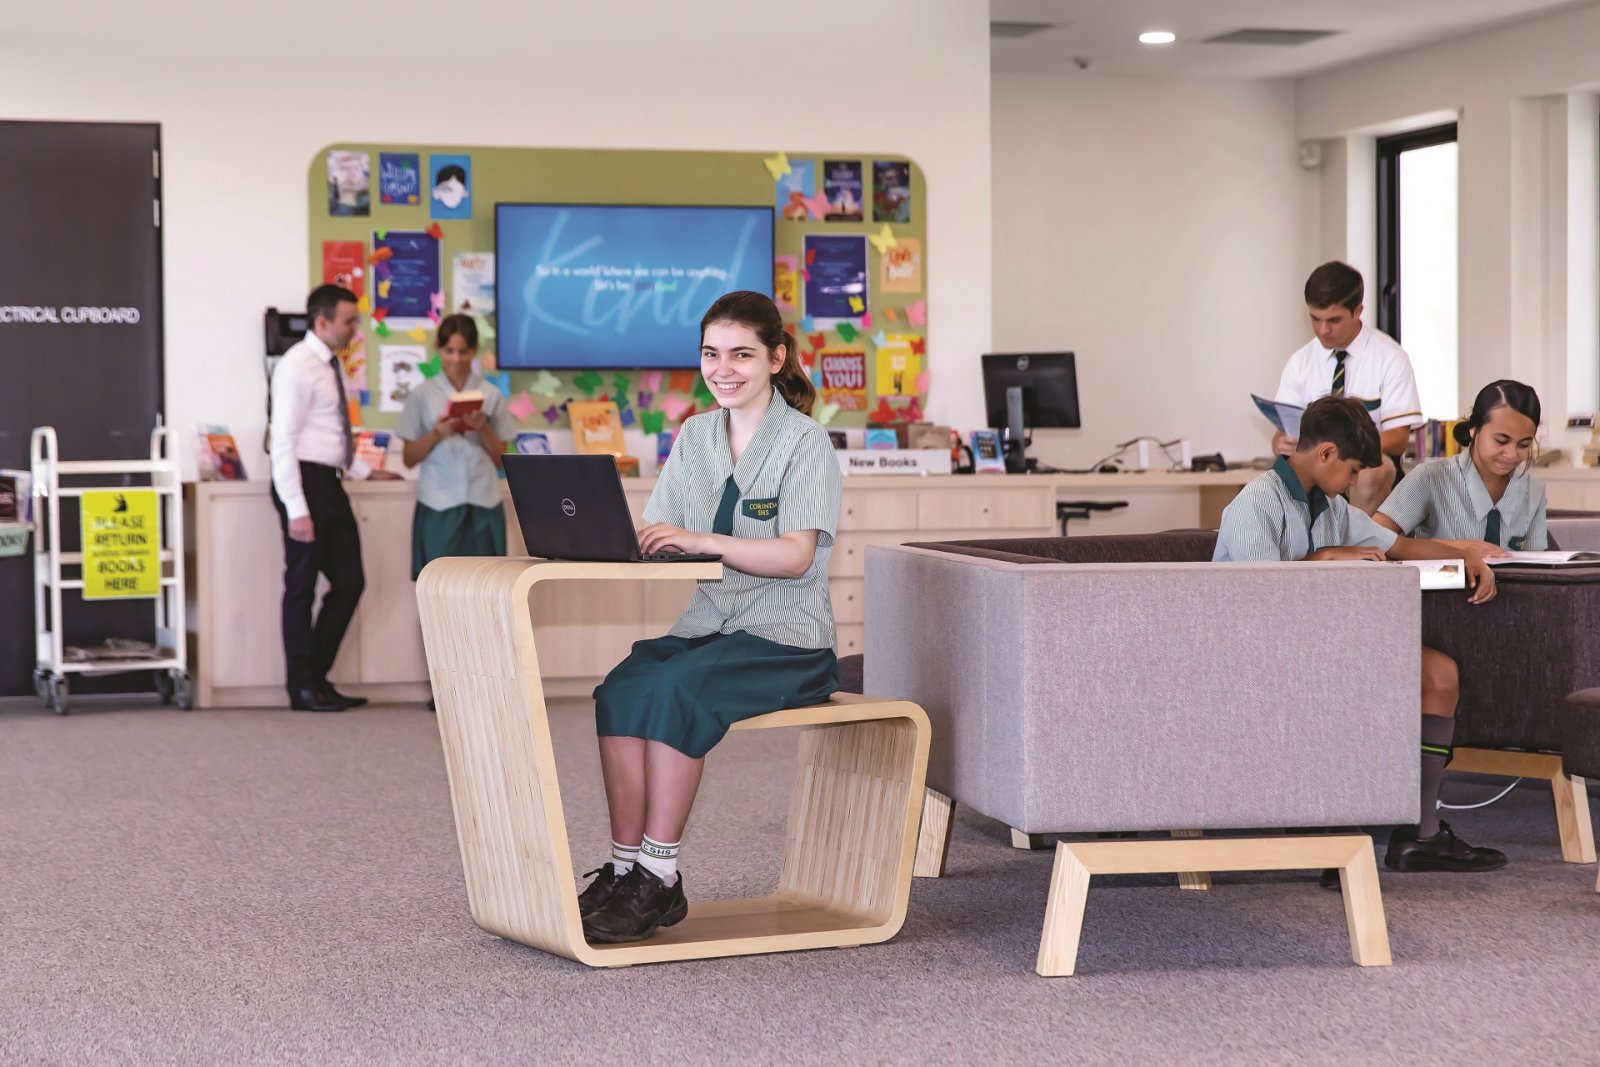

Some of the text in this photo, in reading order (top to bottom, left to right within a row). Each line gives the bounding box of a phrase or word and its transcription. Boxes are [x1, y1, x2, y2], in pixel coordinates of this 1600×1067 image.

[61, 306, 140, 324] CUPBOARD
[823, 356, 863, 371] CHOOSE
[849, 456, 918, 468] New Books
[94, 514, 145, 530] PLEASE
[94, 532, 148, 546] RETURN
[98, 559, 146, 573] BOOKS
[104, 577, 137, 590] HERE
[643, 844, 672, 855] CSHS
